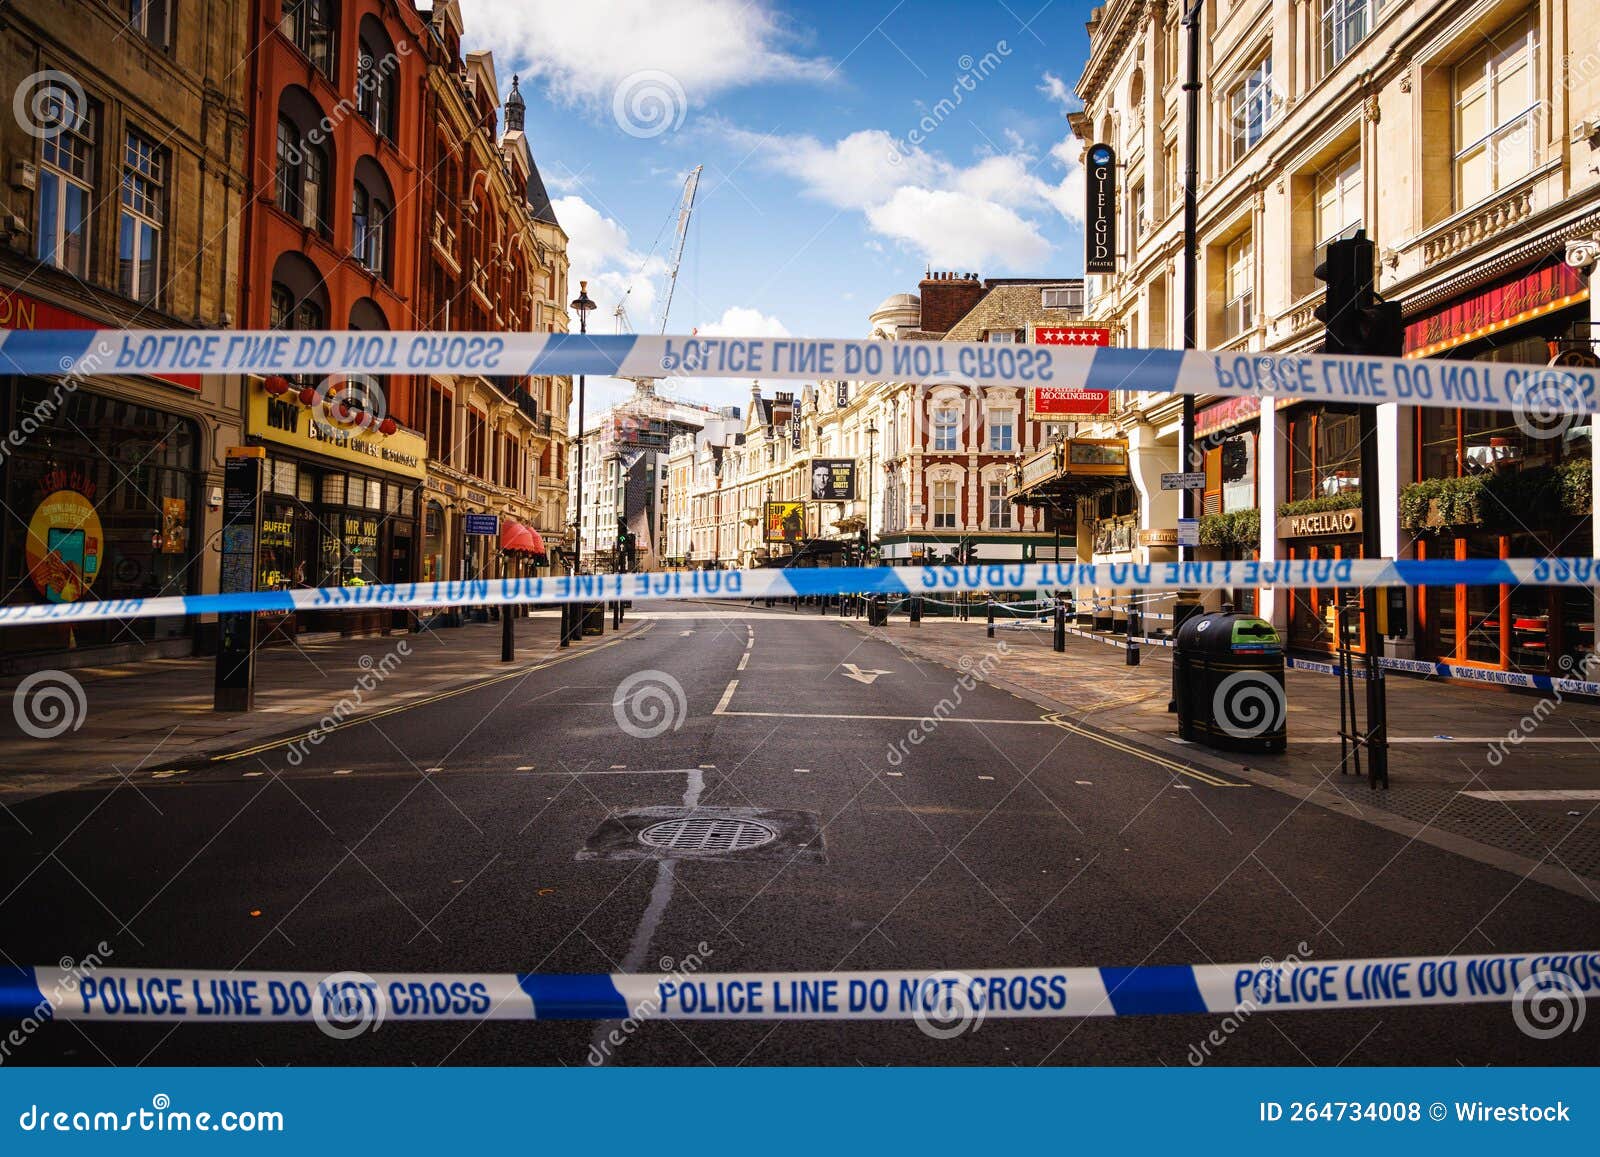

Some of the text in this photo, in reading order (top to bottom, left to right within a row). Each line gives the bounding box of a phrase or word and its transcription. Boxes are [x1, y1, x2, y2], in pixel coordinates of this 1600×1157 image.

[1095, 167, 1108, 259] GIELGUD
[1040, 391, 1104, 400] MOCKINGBIRD
[263, 520, 292, 533] BUFFET
[345, 519, 378, 536] MR WU
[1291, 513, 1354, 534] MACELLAIO
[659, 974, 1067, 1014] POLICE LINE DO NOT CROSS
[1234, 966, 1338, 1004] POLICE
[1345, 964, 1408, 1002] LINE
[1417, 961, 1459, 999] DO
[1465, 957, 1529, 996] NOT
[80, 977, 491, 1016] POLICE LINE DO NOT CROSS
